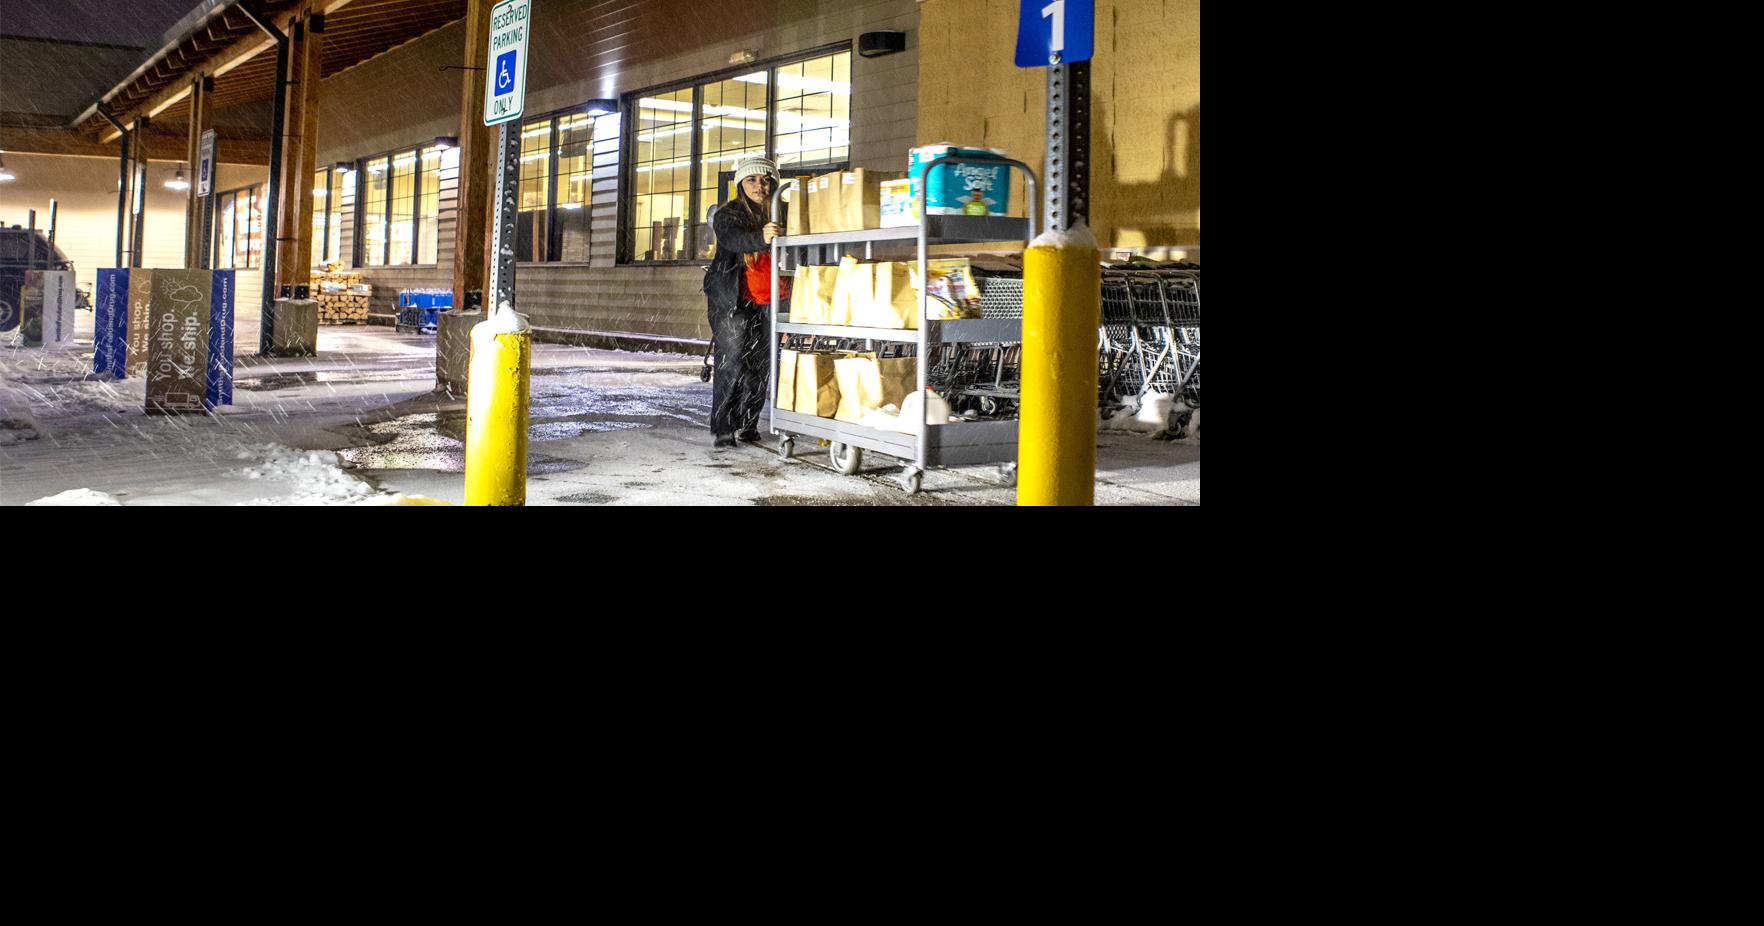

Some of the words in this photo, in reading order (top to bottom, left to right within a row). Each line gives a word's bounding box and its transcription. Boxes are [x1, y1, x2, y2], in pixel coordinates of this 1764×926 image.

[493, 4, 527, 31] RESERVED
[1041, 0, 1064, 51] 1
[493, 27, 523, 51] PARKING
[494, 96, 514, 115] ONLY
[954, 163, 999, 180] Angel
[963, 176, 994, 191] Soft
[132, 298, 142, 330] shop.
[157, 308, 178, 350] shop.
[180, 311, 200, 350] ship.
[131, 333, 140, 354] You
[141, 333, 150, 353] We
[155, 353, 172, 381] You
[178, 355, 195, 380] We
